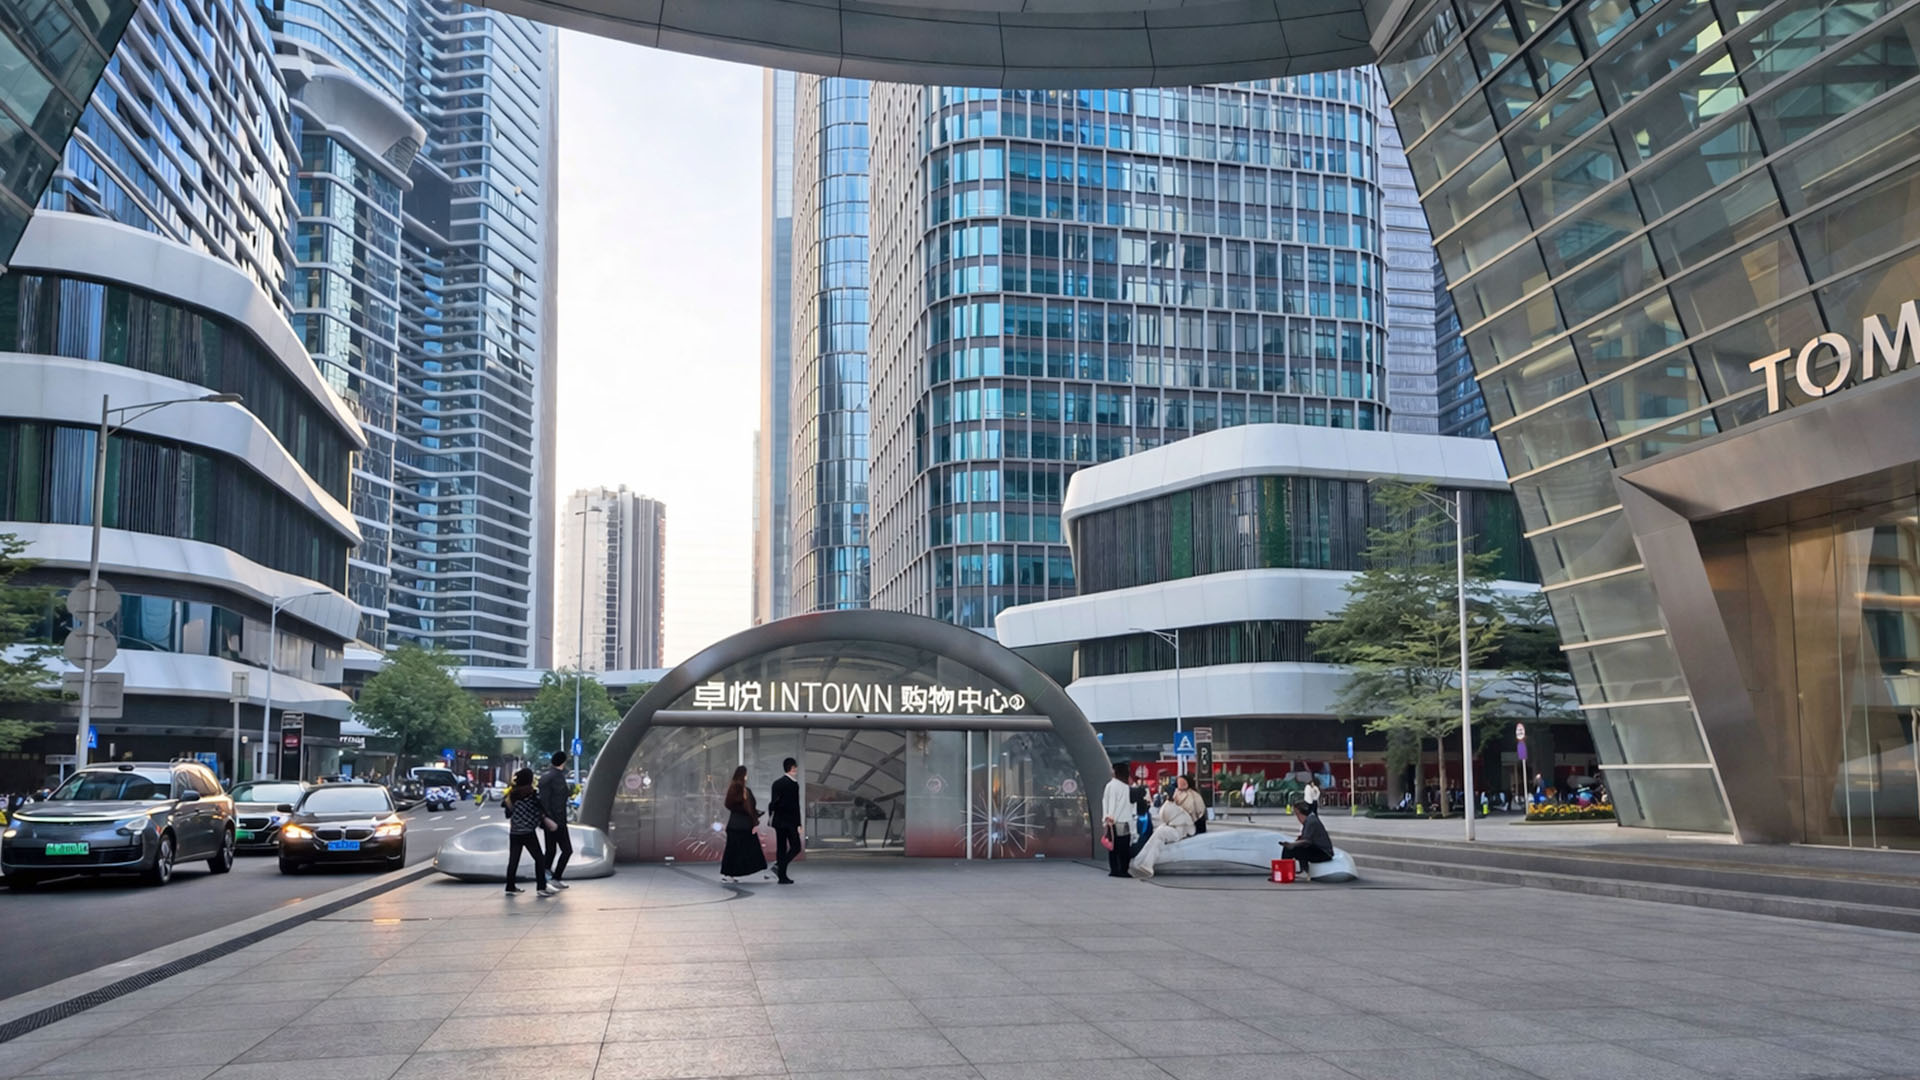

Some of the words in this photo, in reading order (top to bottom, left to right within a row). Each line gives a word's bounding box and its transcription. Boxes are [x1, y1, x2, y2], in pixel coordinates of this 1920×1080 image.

[1749, 299, 1920, 414] TOM
[693, 681, 762, 711] 卓悦
[770, 682, 892, 712] INTOWN
